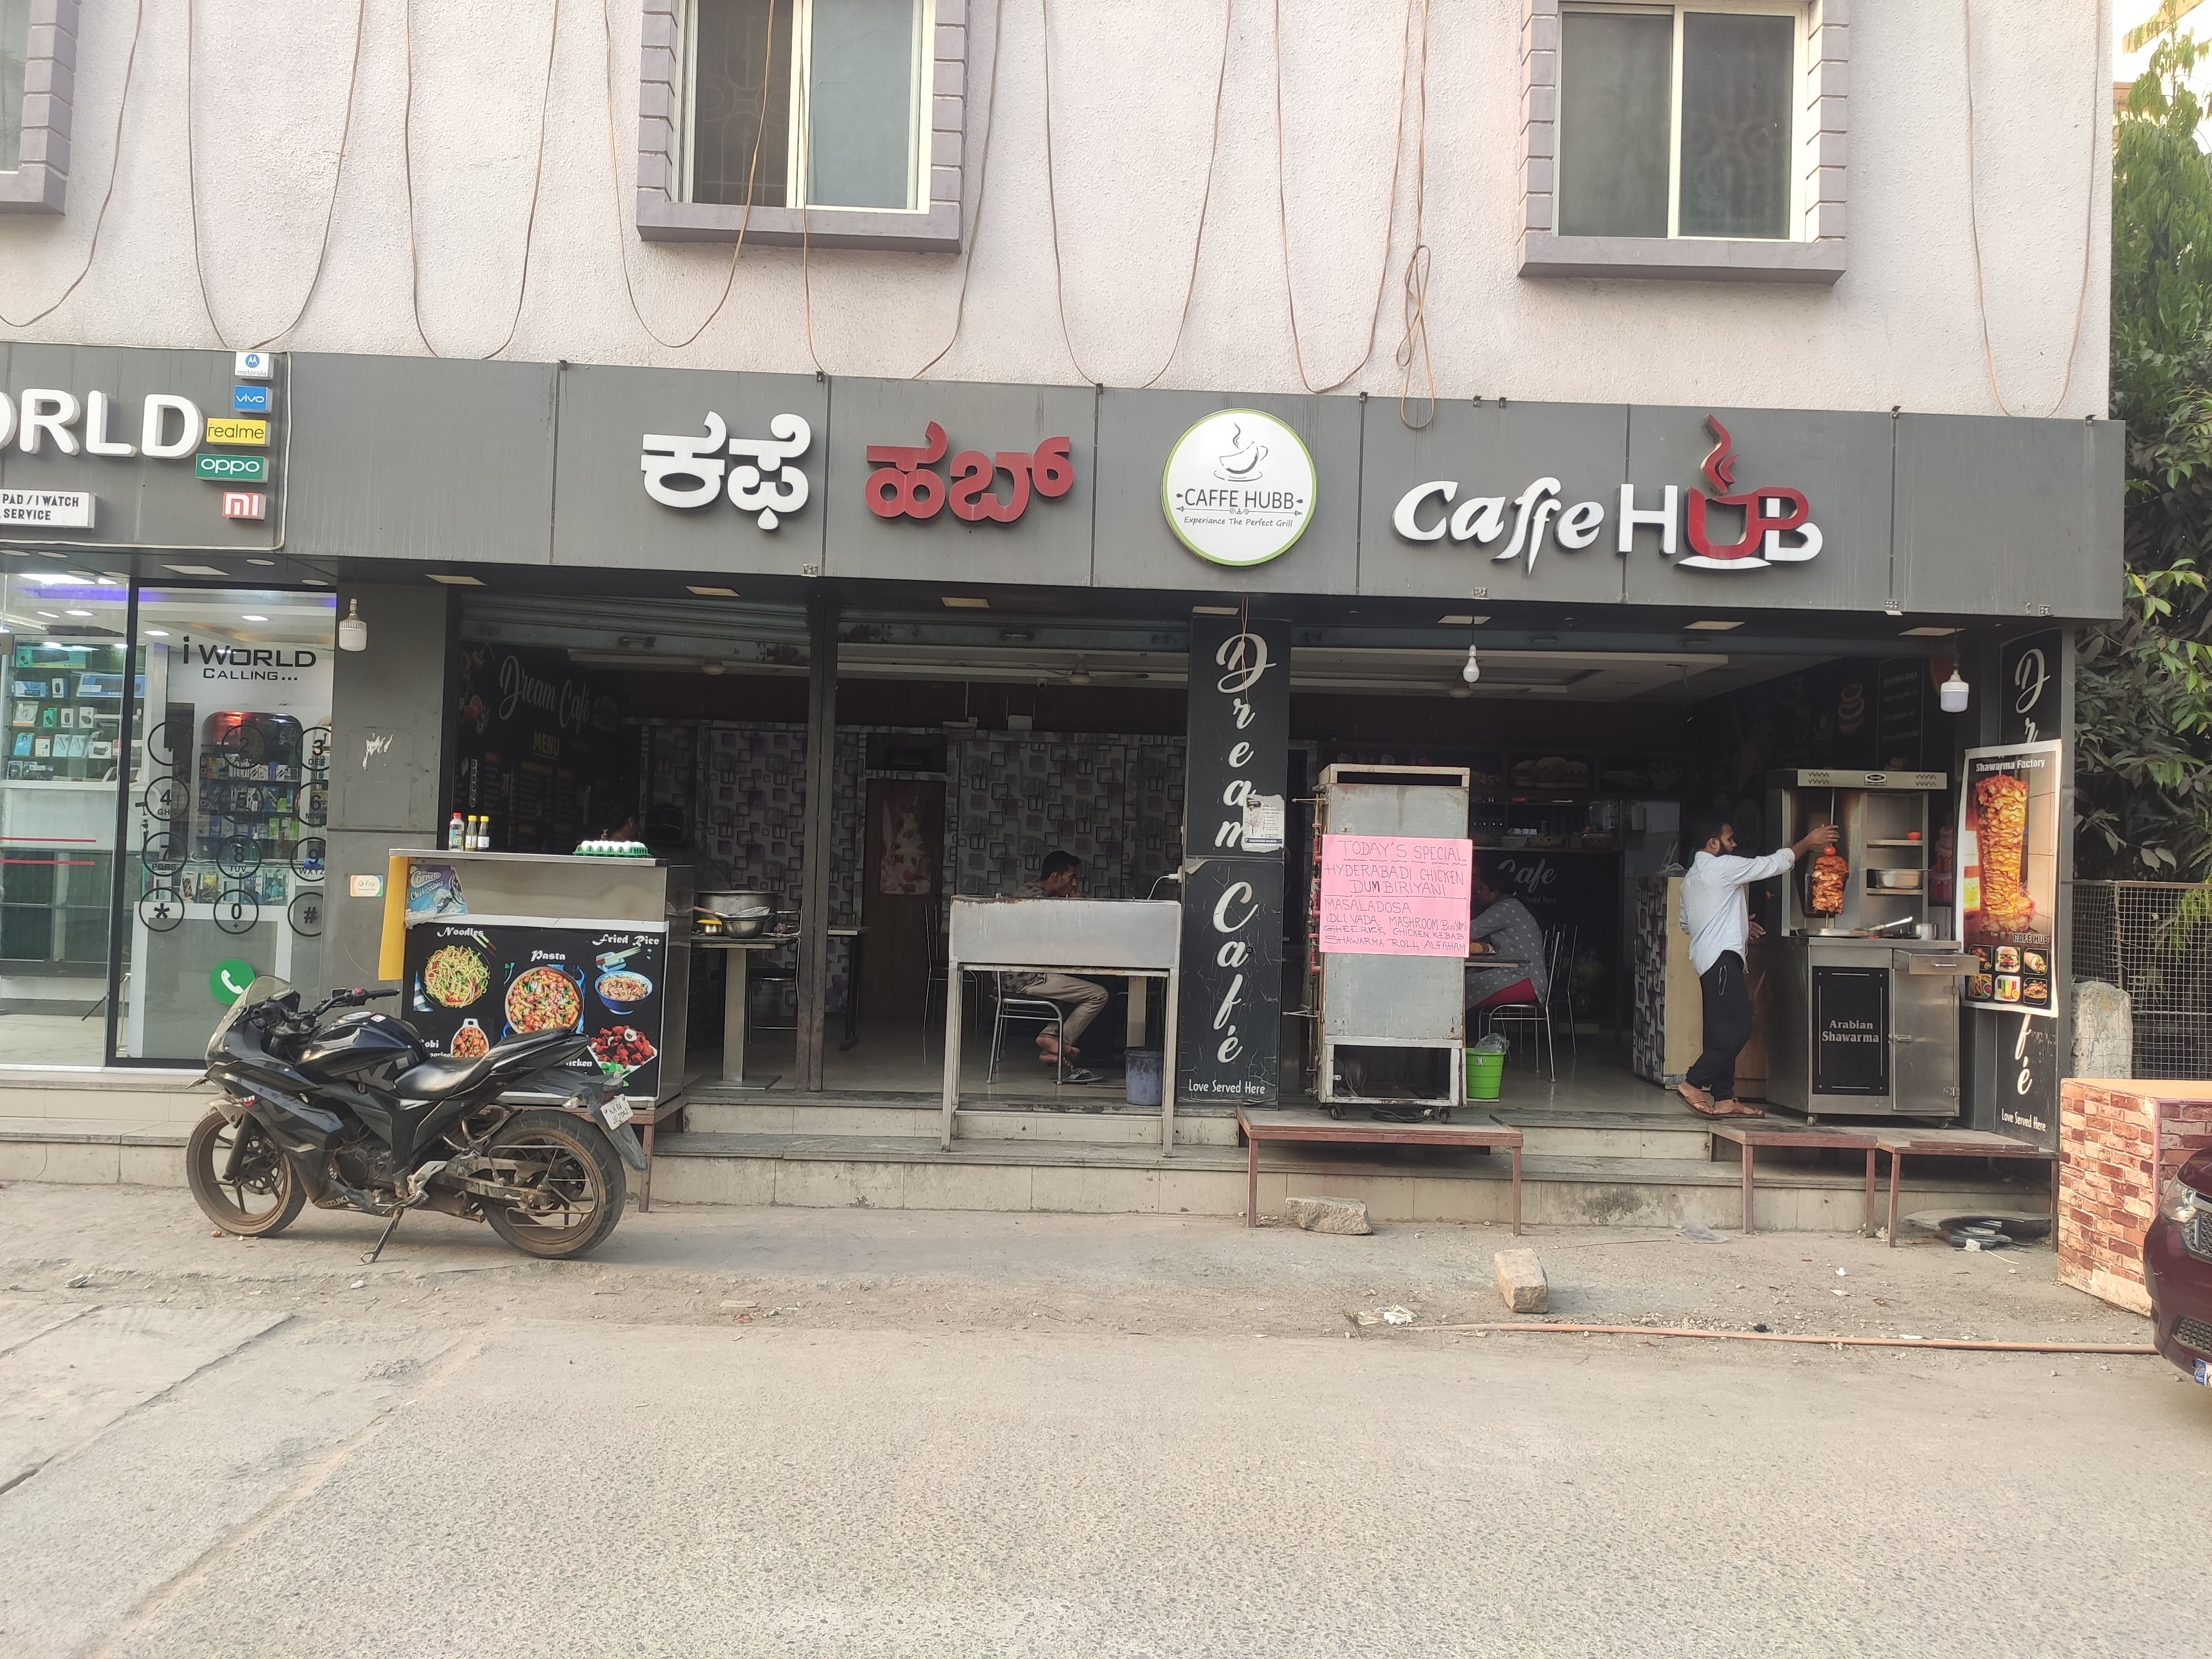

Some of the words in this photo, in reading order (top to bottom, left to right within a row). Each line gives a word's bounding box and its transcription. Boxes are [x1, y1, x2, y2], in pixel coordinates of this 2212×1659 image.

[236, 393, 265, 403] vivo
[208, 424, 264, 439] realme
[201, 458, 260, 475] oppo
[864, 421, 1074, 523] ಹಬ್
[41, 495, 80, 507] WATCH
[1185, 489, 1239, 508] CAFFE
[1245, 491, 1294, 509] HUBB
[3, 509, 51, 520] SERVICE
[1184, 517, 1226, 526] Experiance
[1245, 518, 1274, 526] Perfect
[1392, 477, 1605, 576] Caffe
[1616, 483, 1824, 566] HUB
[198, 644, 316, 667] WORLD
[499, 655, 557, 721] Dream
[312, 739, 324, 757] 3
[533, 732, 560, 756] MENU
[1975, 761, 2016, 773] Shawarma
[2017, 759, 2046, 769] Factory
[160, 789, 172, 807] 4
[310, 795, 322, 811] 6
[1337, 841, 1407, 858] TODAY'S
[1414, 846, 1467, 862] SPECIAL
[410, 870, 442, 889] Cornetto
[1324, 863, 1412, 880] HYDERABADI
[1420, 868, 1464, 885] CHICKEN
[365, 880, 375, 888] Pay
[1349, 880, 1380, 893] DUM
[1383, 881, 1446, 896] BIRIYANI
[1389, 916, 1438, 931] MASHROOM
[436, 926, 484, 938] Noodles
[1432, 931, 1464, 940] KEBAB
[2013, 931, 2032, 944] CAFÉ
[2033, 934, 2049, 945] HUB
[592, 933, 628, 946] Fried
[633, 935, 660, 947] Rice
[1324, 935, 1385, 947] SHAWARMA
[1423, 940, 1466, 956] ALFAHAM
[531, 950, 566, 962] Pasta
[1829, 1020, 1874, 1029] Arabian
[419, 1039, 439, 1048] obi
[1822, 1031, 1880, 1043] Shawarma
[1189, 1079, 1209, 1092] Love
[1212, 1079, 1241, 1093] Served
[1245, 1081, 1266, 1094] Here
[609, 1106, 617, 1115] KA
[2001, 1108, 2013, 1124] Love
[2015, 1111, 2032, 1129] Served
[2033, 1115, 2046, 1133] Here
